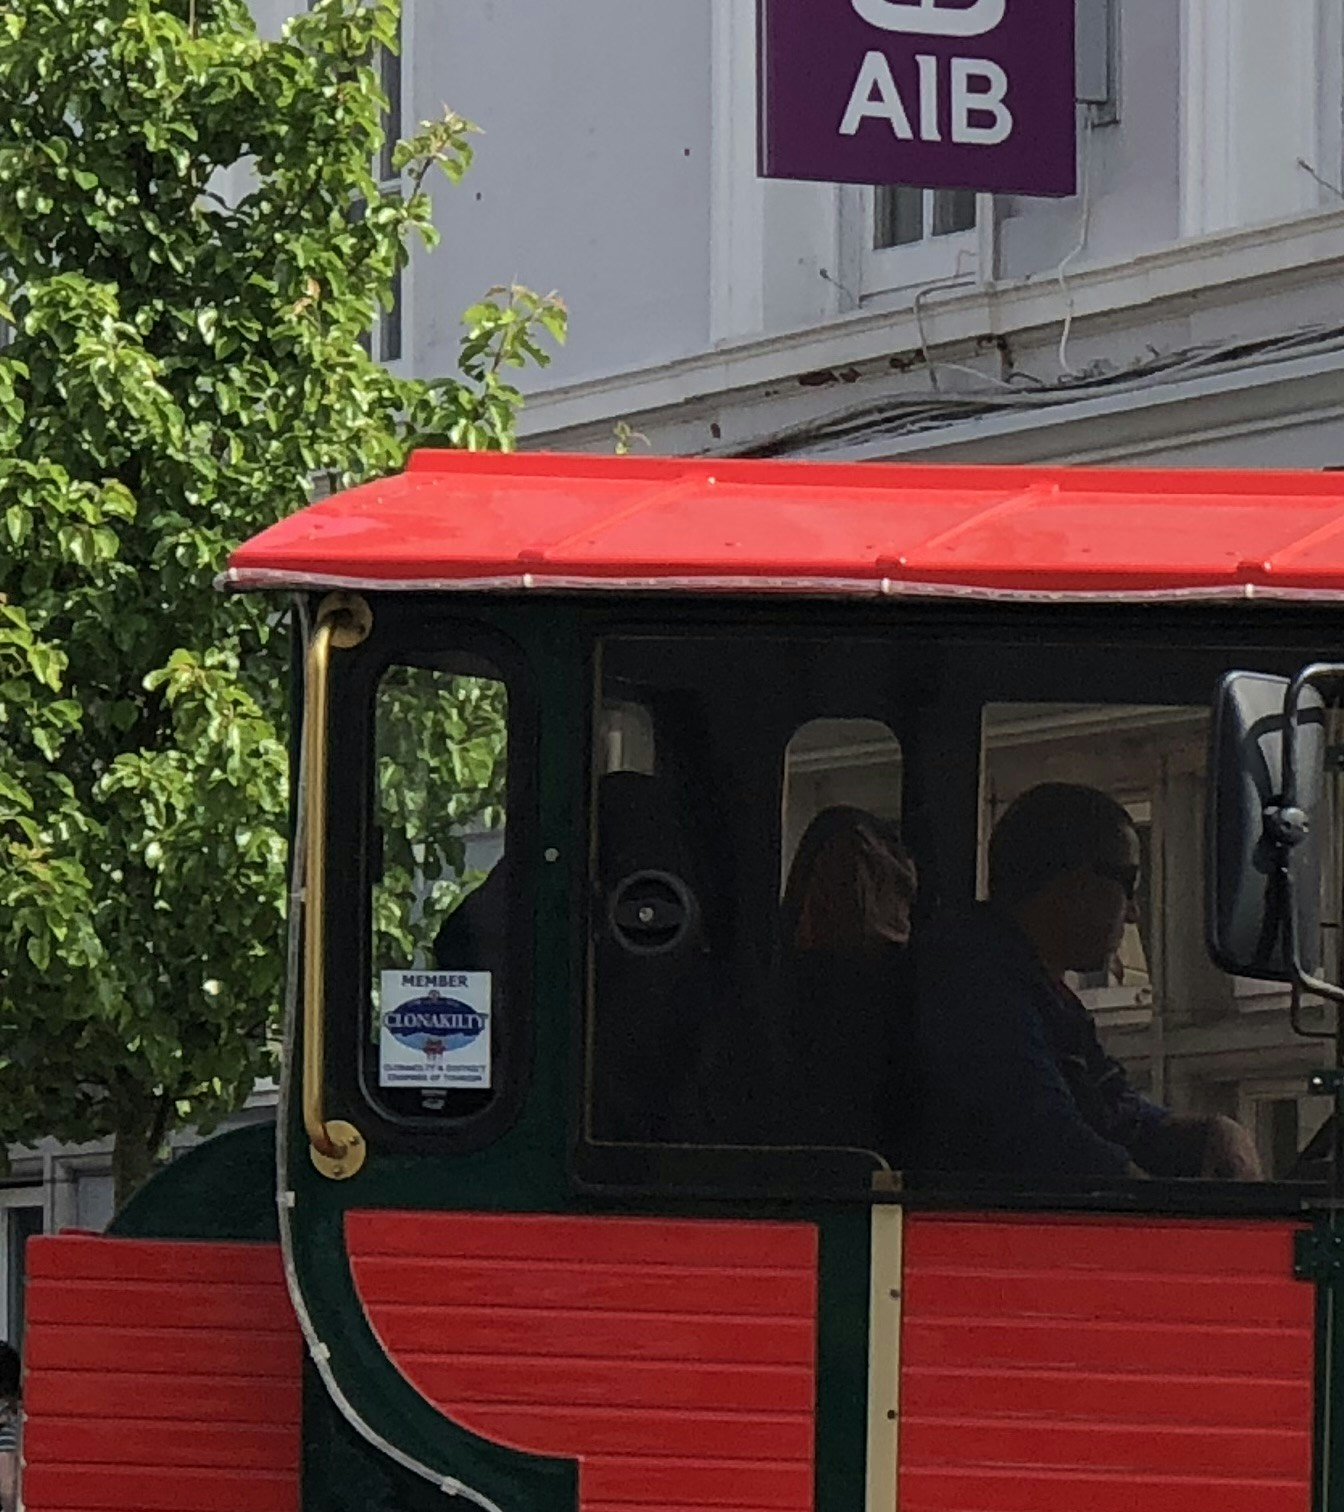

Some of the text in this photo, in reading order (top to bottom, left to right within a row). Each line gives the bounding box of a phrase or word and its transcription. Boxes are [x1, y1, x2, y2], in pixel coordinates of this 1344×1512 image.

[839, 50, 1013, 145] AIB
[402, 975, 469, 988] MEMBER
[383, 1012, 485, 1029] CLONAKILTY
